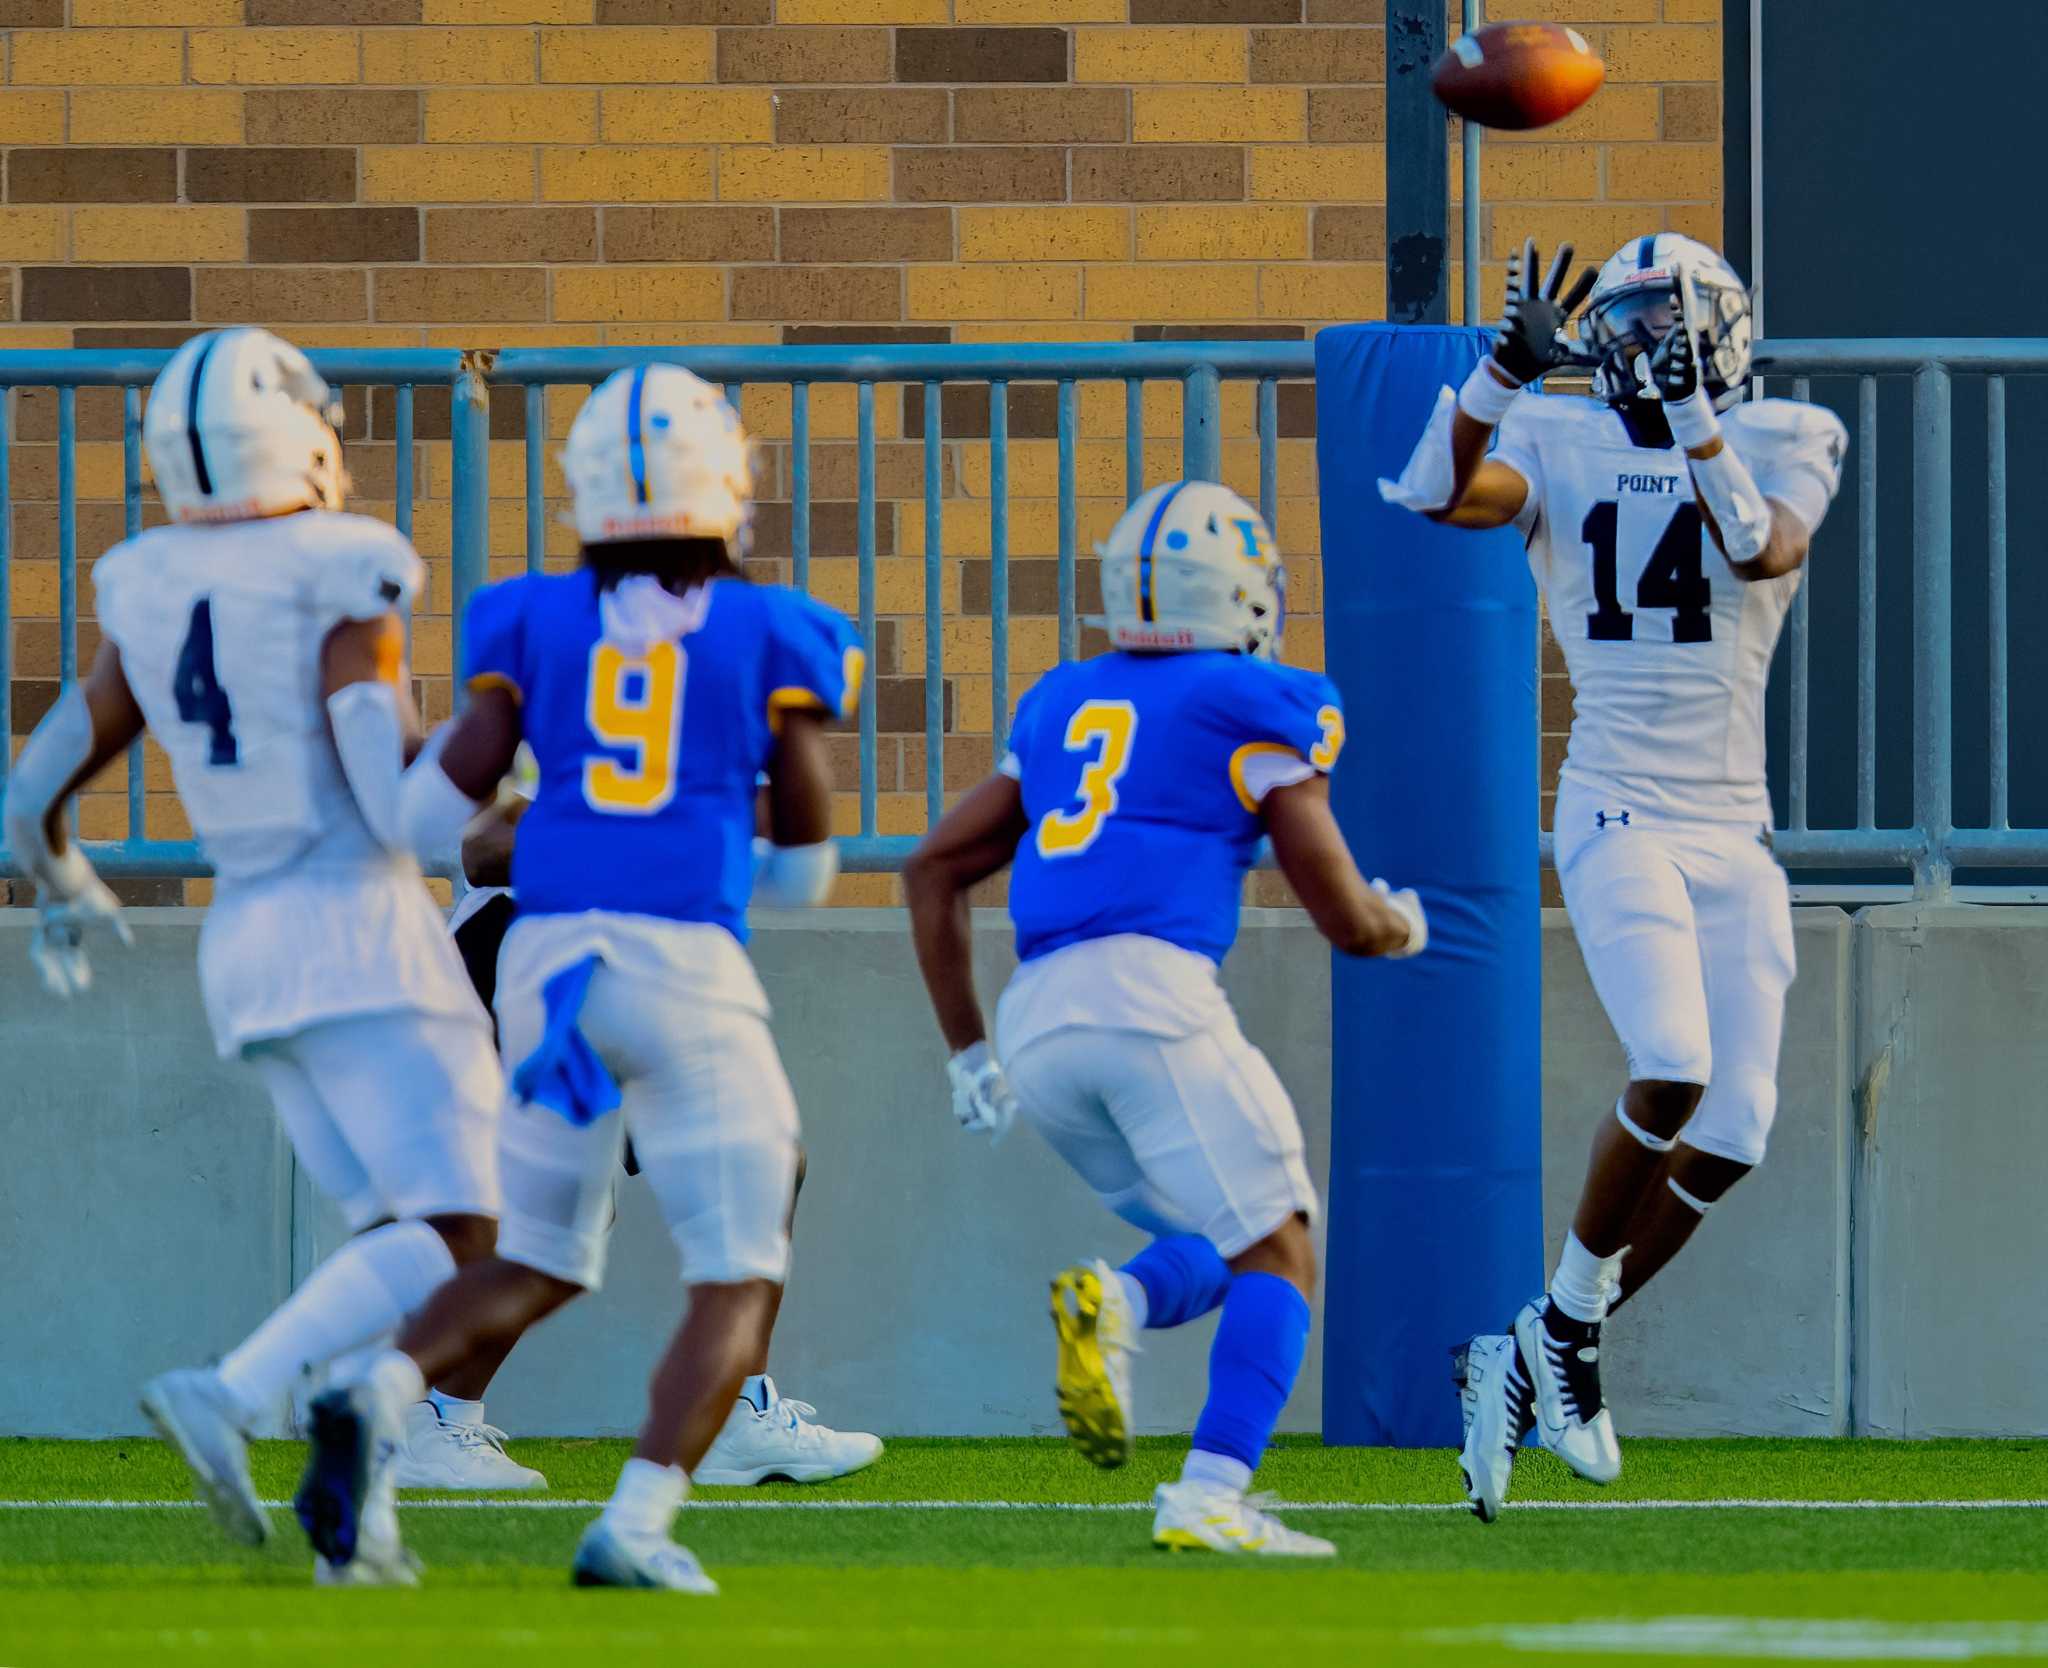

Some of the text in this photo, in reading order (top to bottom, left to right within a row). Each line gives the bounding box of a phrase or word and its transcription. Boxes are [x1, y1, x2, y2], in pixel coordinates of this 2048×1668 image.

[1617, 474, 1679, 494] POINT
[1582, 500, 1712, 643] 14
[173, 597, 239, 766] 4
[583, 640, 687, 814] 9
[1309, 705, 1345, 773] 3
[1036, 699, 1138, 859] 3
